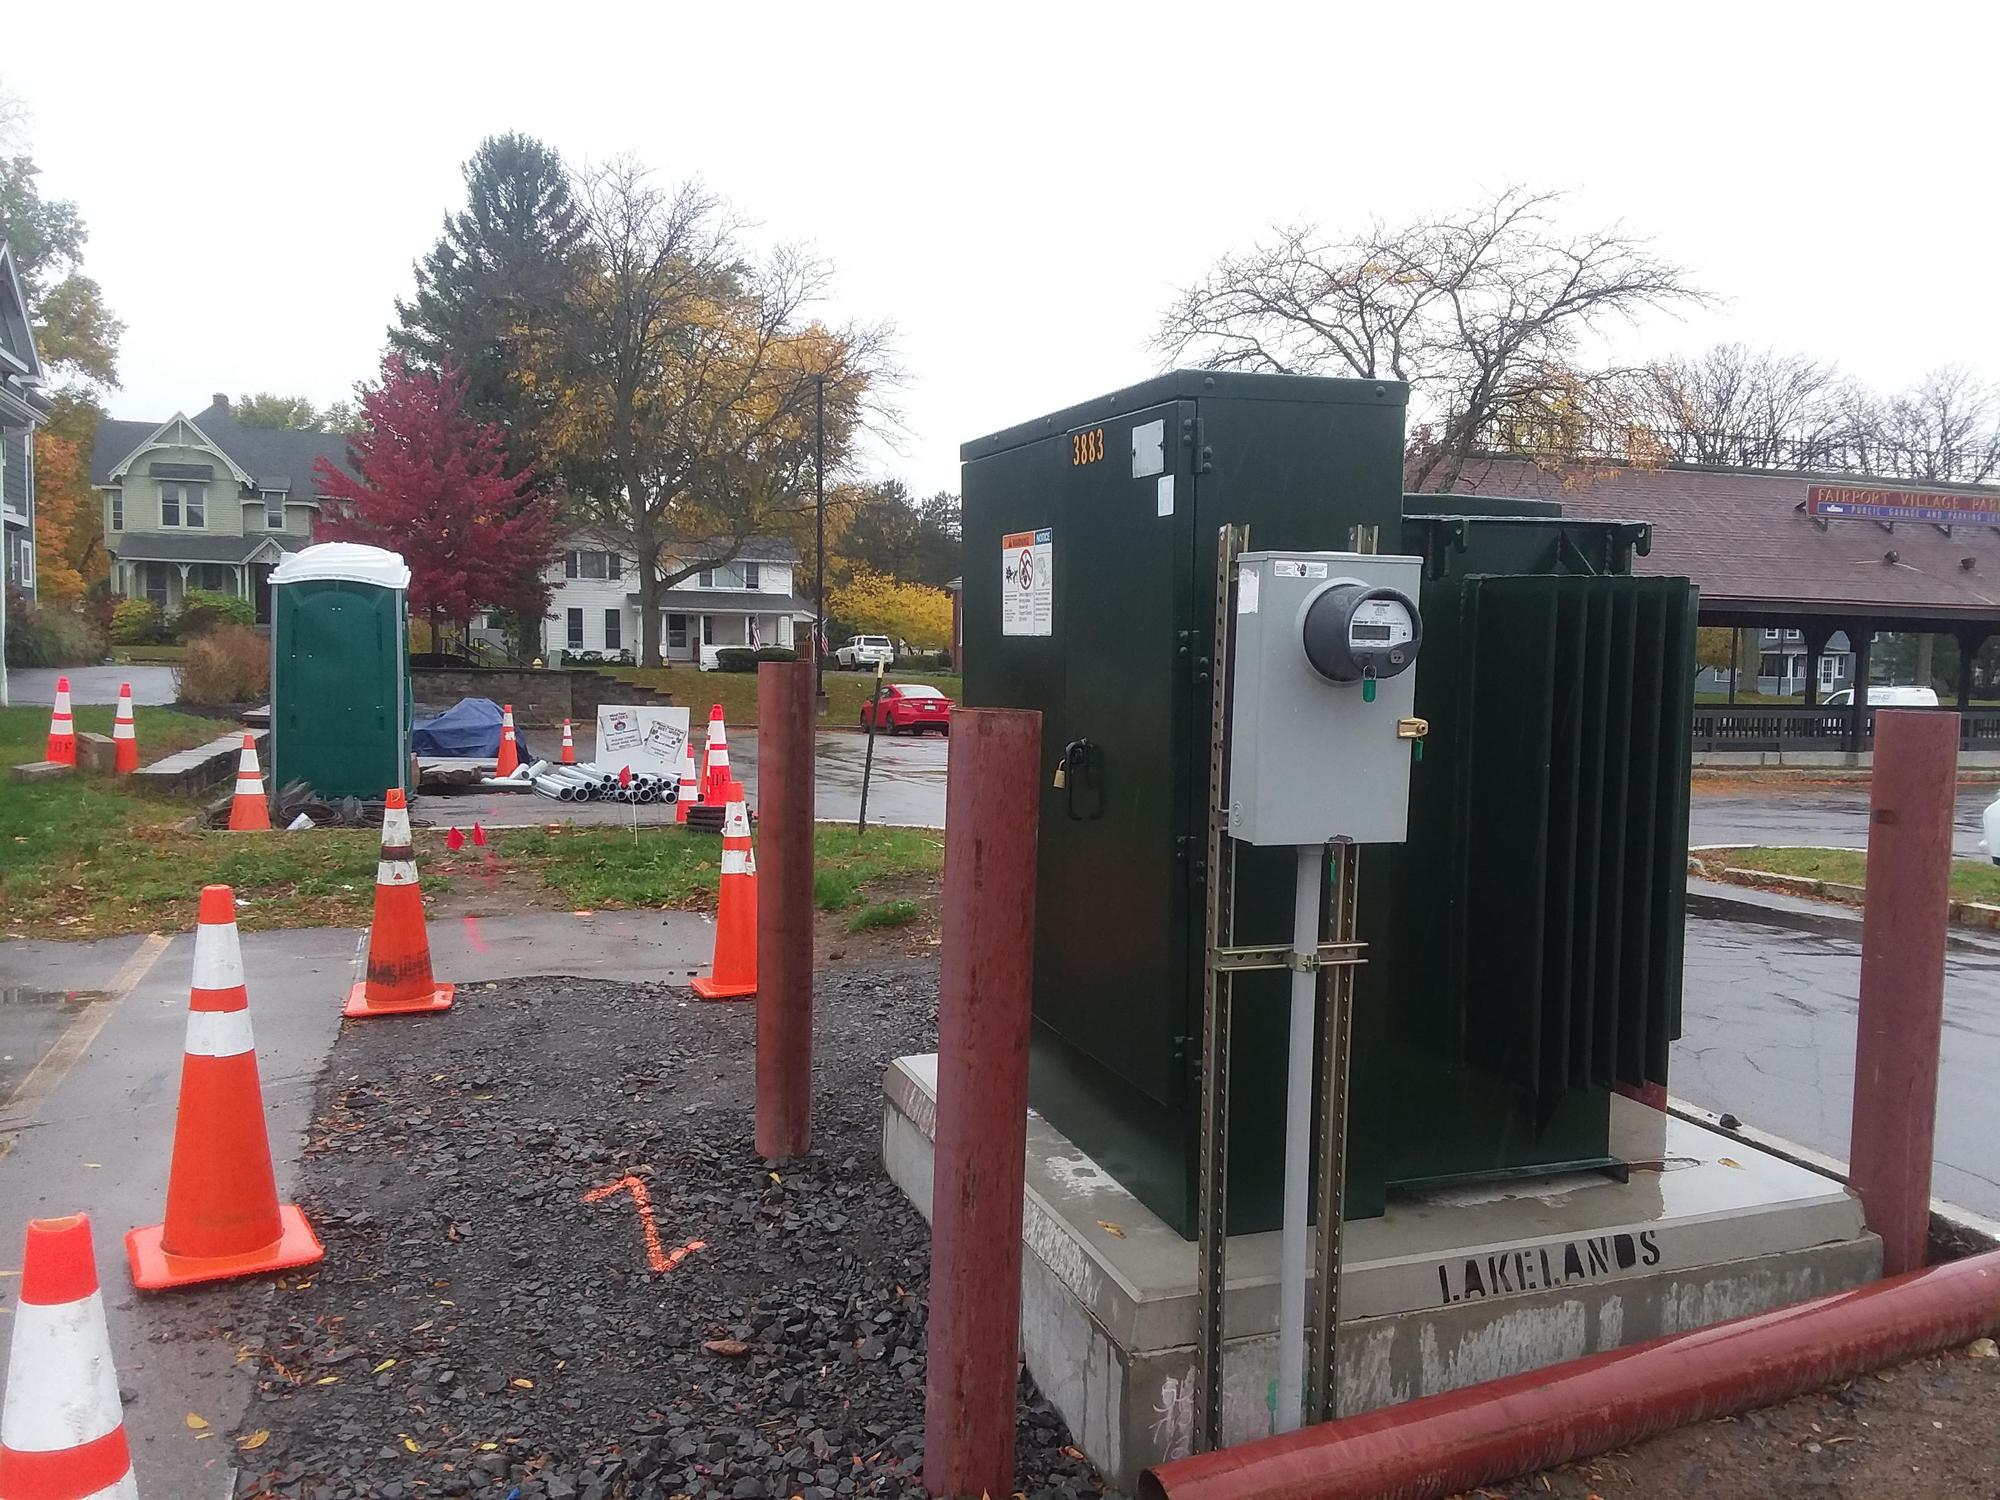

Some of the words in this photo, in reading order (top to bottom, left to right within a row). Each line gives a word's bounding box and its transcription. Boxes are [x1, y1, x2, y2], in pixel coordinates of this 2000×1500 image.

[1073, 428, 1104, 466] 3883
[1818, 488, 1890, 505] FAIRPORT
[1901, 493, 1961, 510] VILLAGE
[1036, 531, 1050, 543] NOTICE
[1438, 1230, 1661, 1304] LAKELANDS
